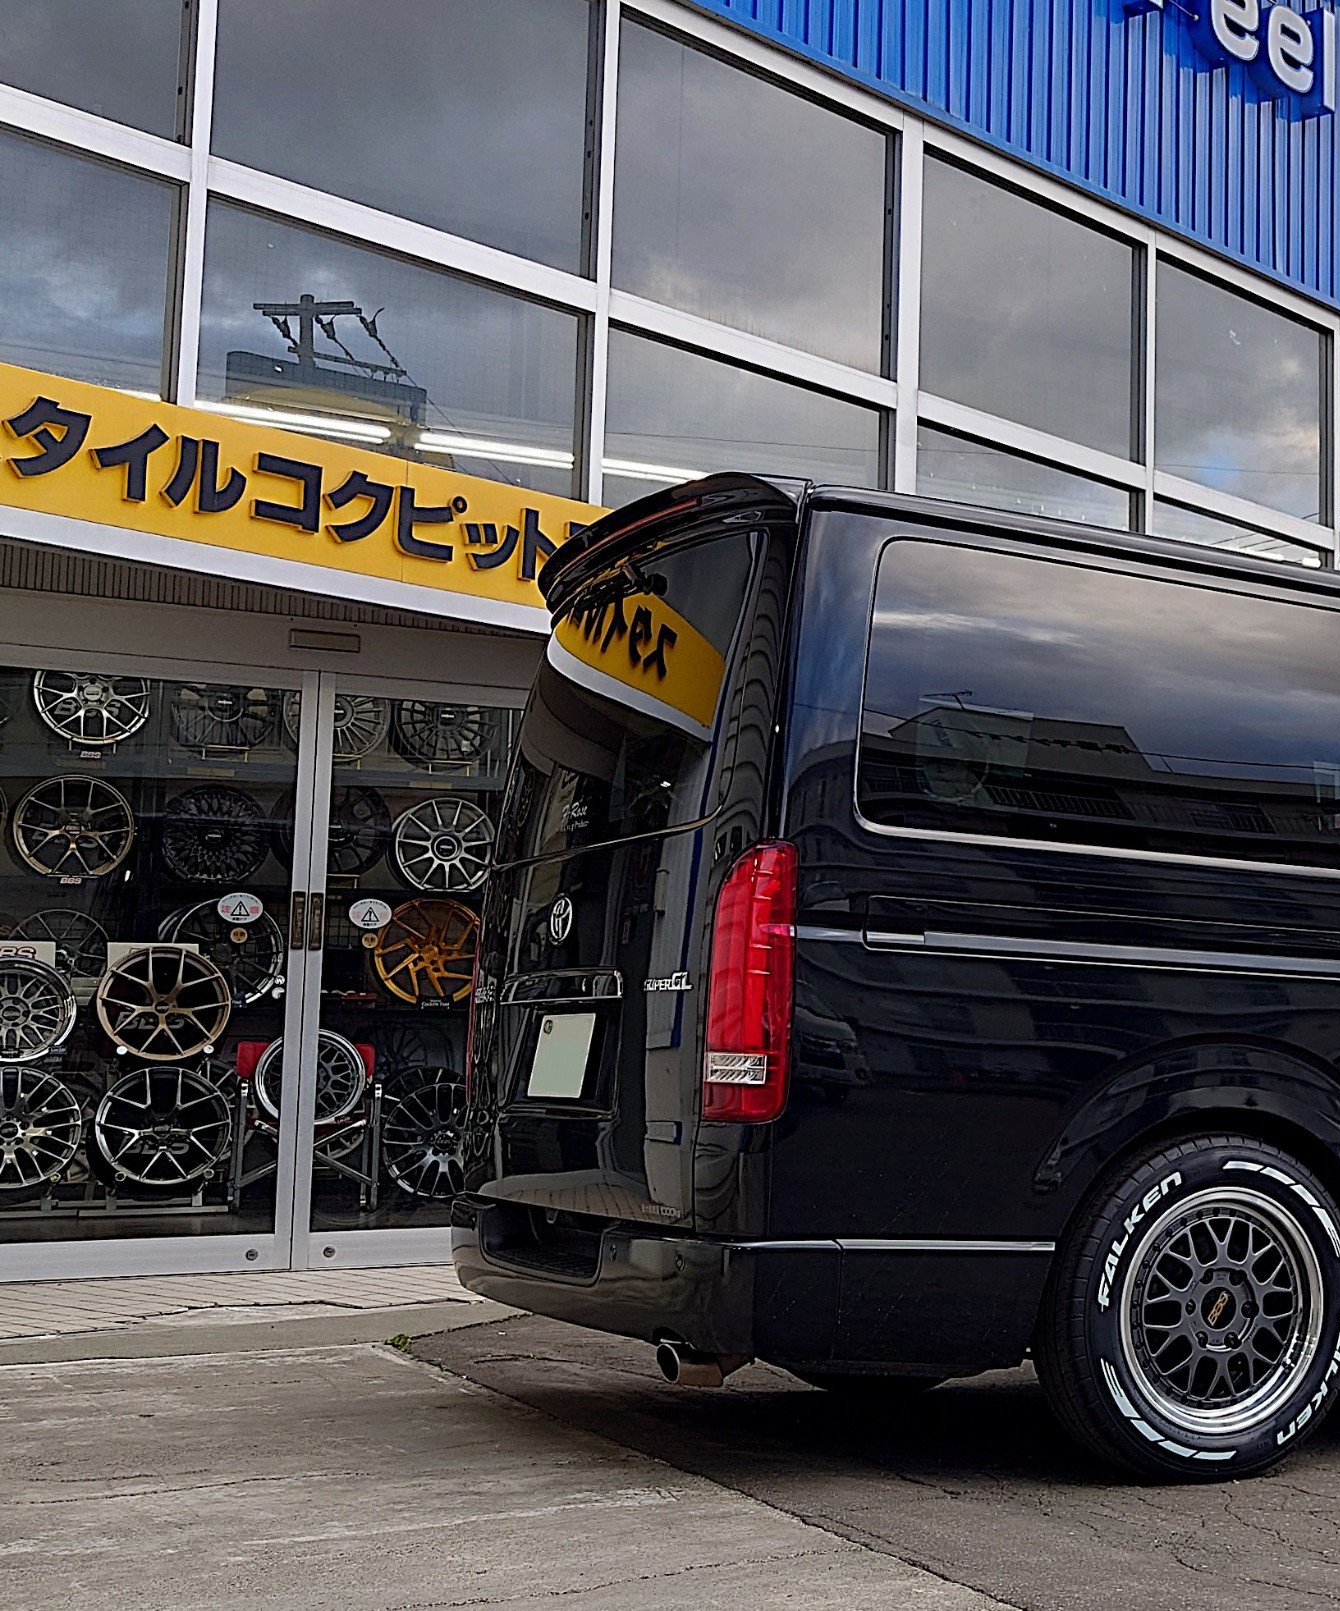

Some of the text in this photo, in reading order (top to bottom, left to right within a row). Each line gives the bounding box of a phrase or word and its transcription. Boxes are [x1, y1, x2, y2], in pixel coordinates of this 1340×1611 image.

[1146, 0, 1336, 112] eel
[0, 395, 600, 581] タイルコクピット
[1207, 1290, 1229, 1326] BBS
